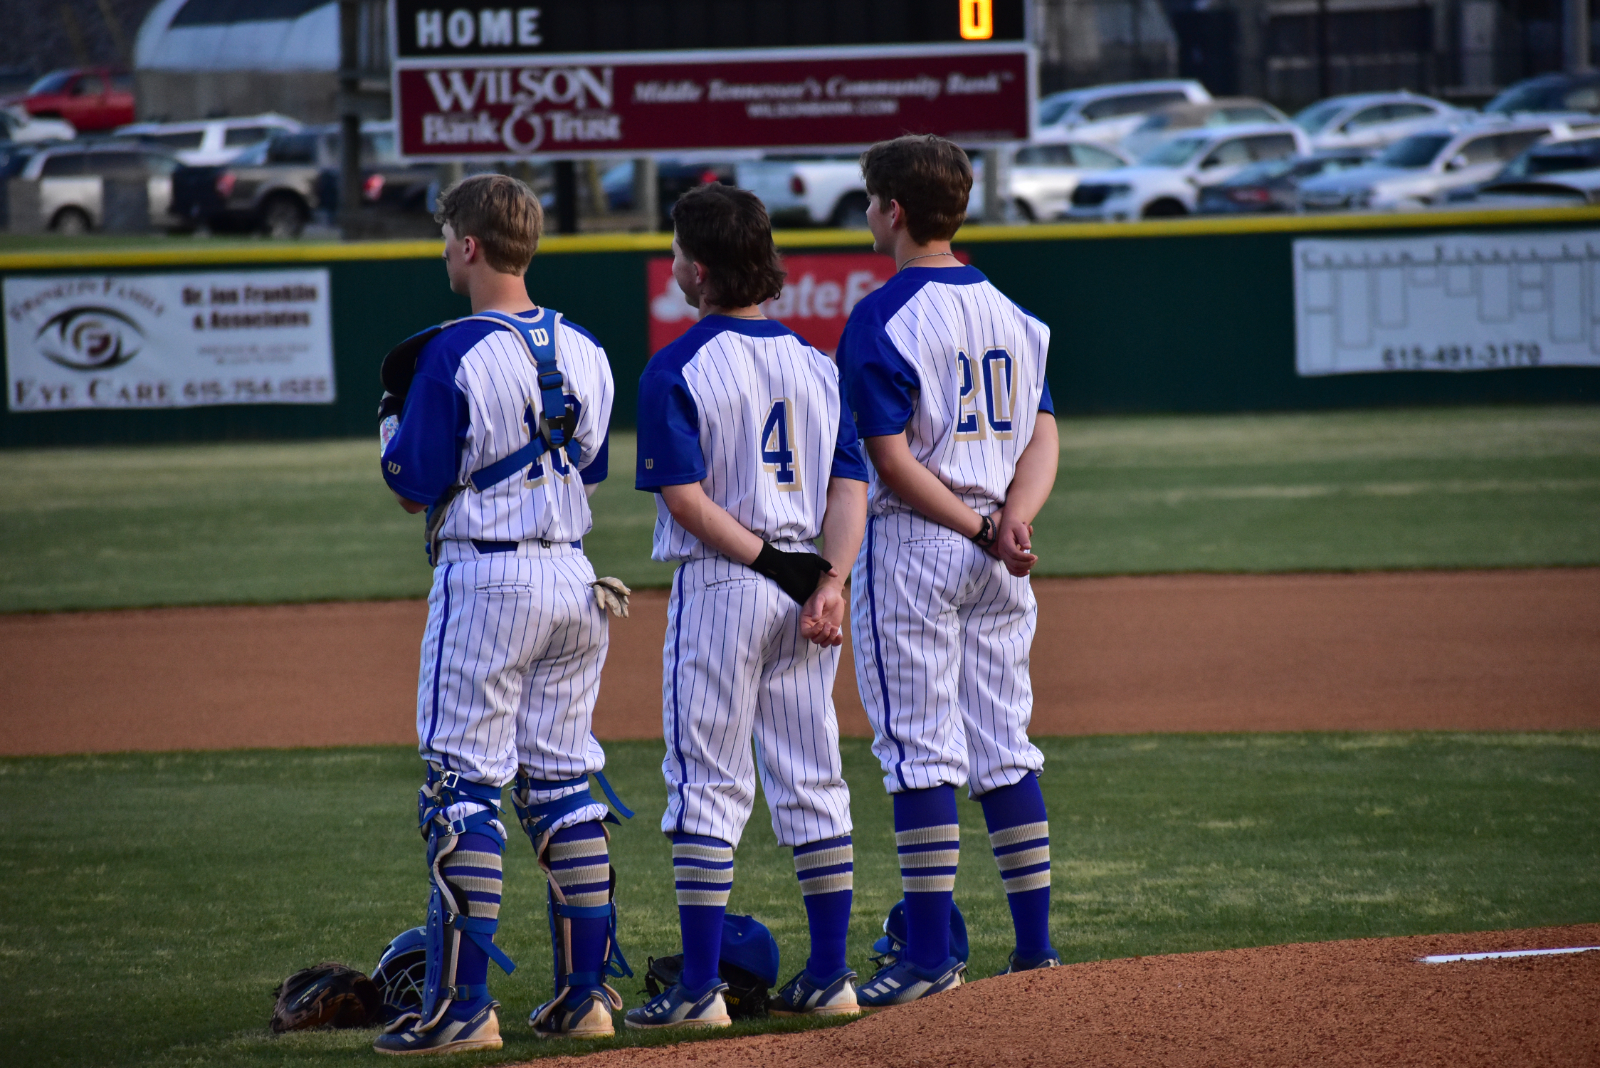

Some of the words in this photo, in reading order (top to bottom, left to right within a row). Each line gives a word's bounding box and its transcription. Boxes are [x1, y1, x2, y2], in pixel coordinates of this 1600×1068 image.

[415, 8, 541, 48] HOME
[425, 64, 614, 112] WILSON
[421, 110, 499, 145] Bank
[548, 109, 622, 141] Trust
[954, 346, 1017, 441] 20
[762, 397, 801, 492] 4
